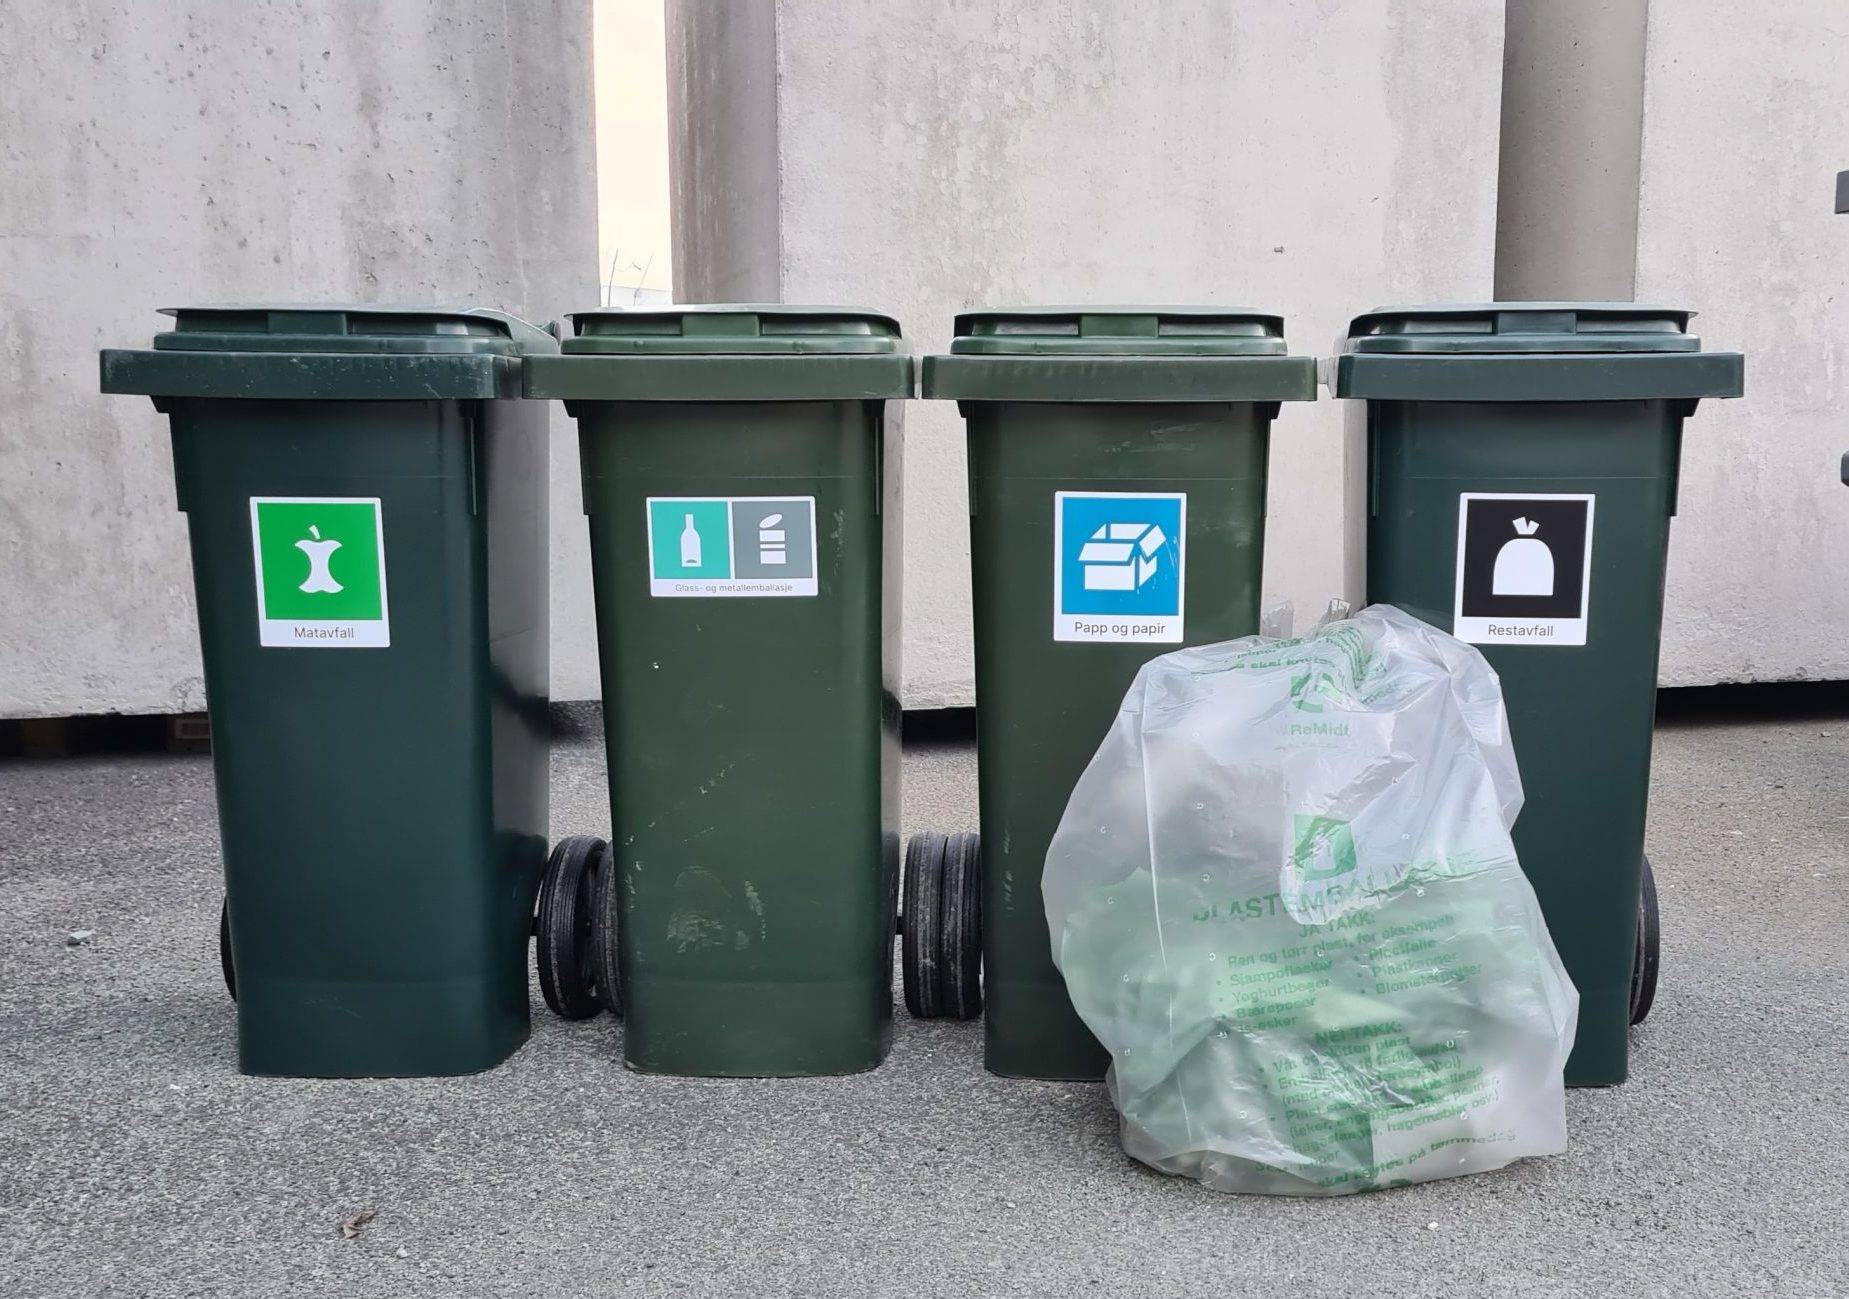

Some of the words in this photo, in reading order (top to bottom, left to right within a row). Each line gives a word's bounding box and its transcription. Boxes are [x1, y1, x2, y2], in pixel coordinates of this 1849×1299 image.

[675, 583, 702, 592] Glass-
[719, 583, 793, 593] metallemballasje
[294, 627, 354, 638] Matavfall
[1075, 622, 1108, 636] Papp
[1112, 624, 1128, 636] og
[1132, 623, 1166, 636] papir
[1488, 625, 1554, 637] Restavfall
[1290, 723, 1350, 737] ReMidt
[1228, 954, 1253, 967] Ren
[1261, 952, 1276, 962] og
[1357, 931, 1377, 942] for
[1233, 976, 1329, 1004] Yoghurtbeger
